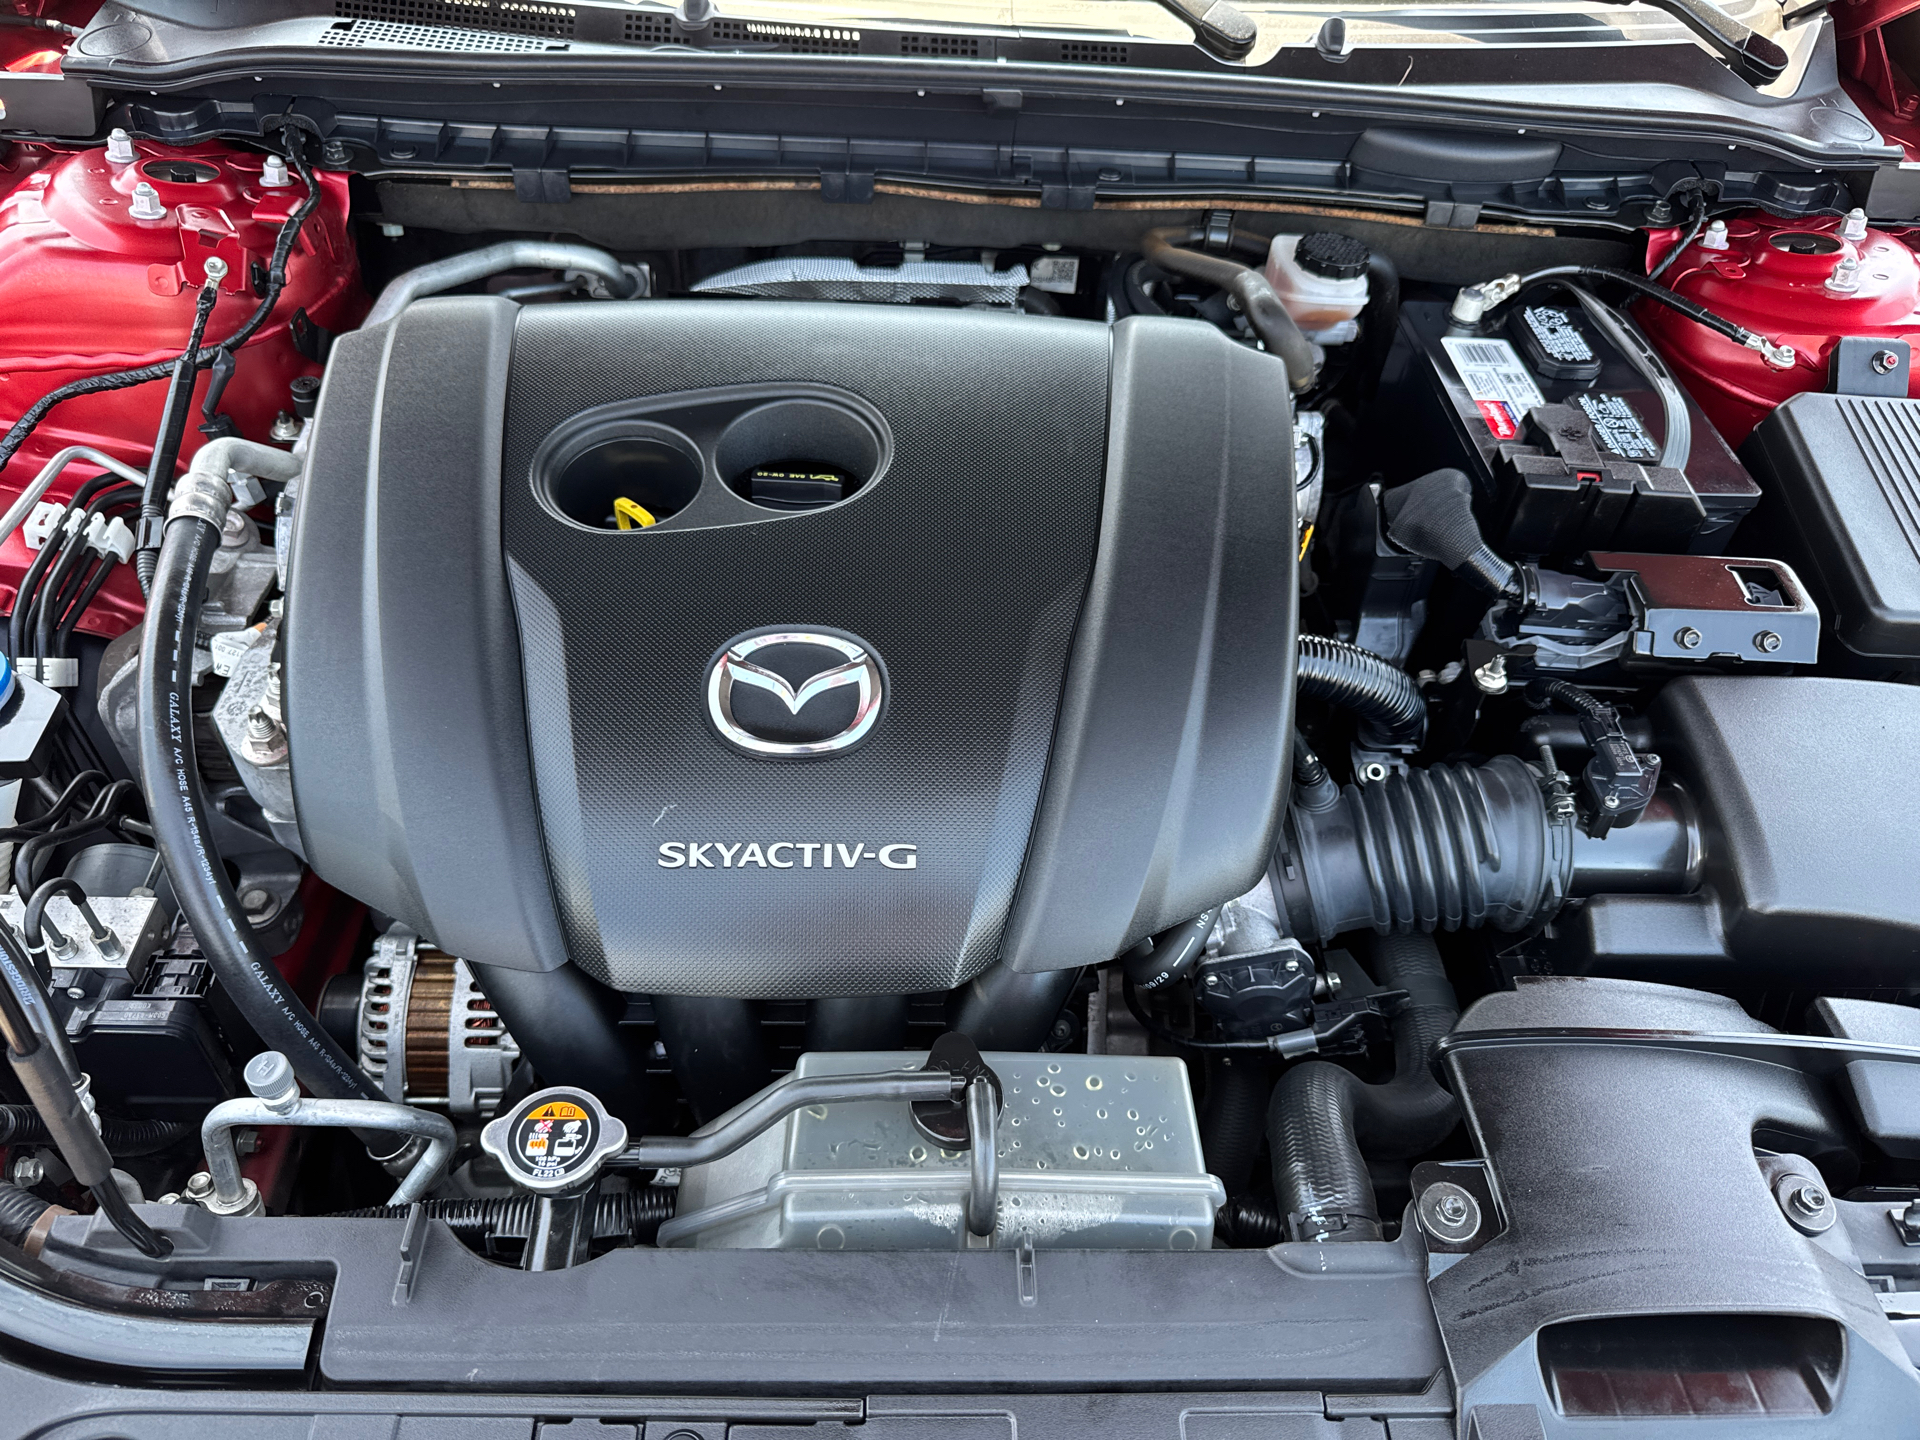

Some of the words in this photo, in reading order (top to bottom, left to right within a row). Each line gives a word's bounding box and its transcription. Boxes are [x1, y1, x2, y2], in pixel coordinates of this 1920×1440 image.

[169, 691, 183, 744] GALAXY
[173, 747, 184, 765] A/C
[176, 768, 189, 791] HOSE
[181, 795, 194, 813] A45
[657, 841, 918, 870] SKYACTIV-G
[250, 961, 286, 1005] GALAXY
[281, 1006, 296, 1021] A/C
[293, 1020, 310, 1039] HOSE
[308, 1036, 321, 1051] A45
[532, 1167, 554, 1178] FL22
